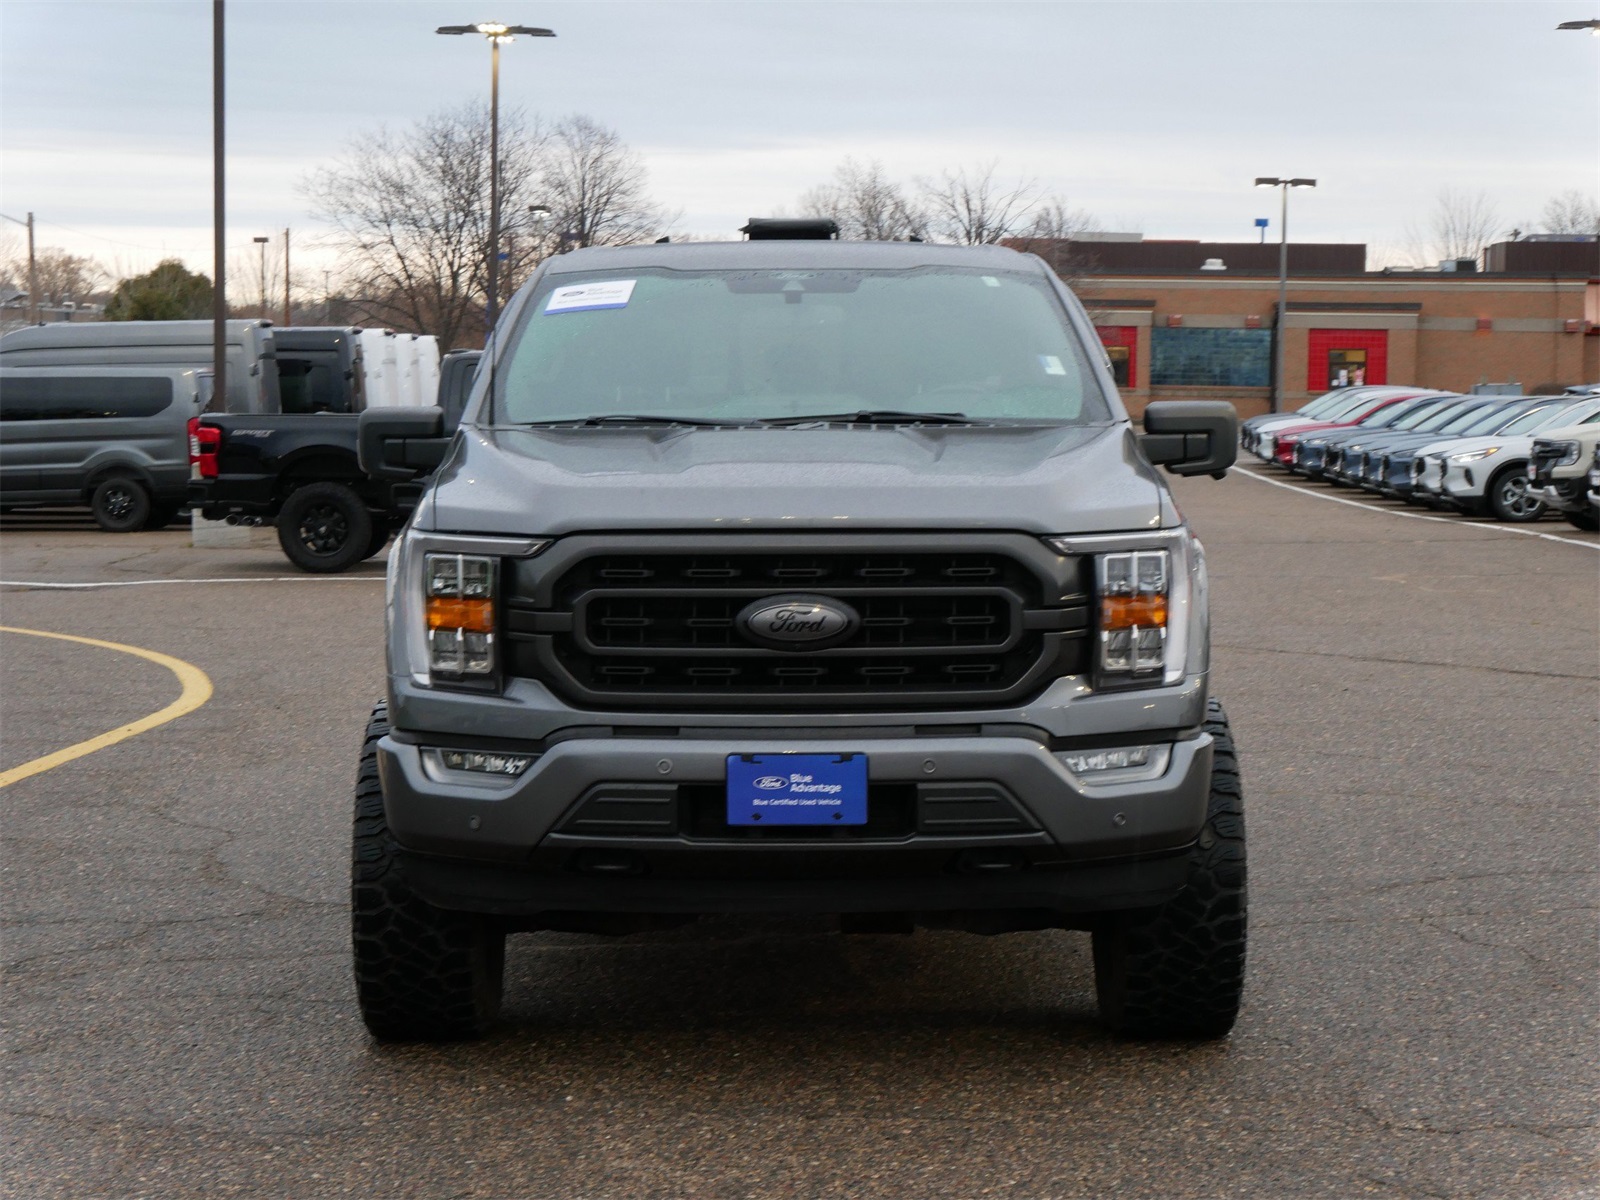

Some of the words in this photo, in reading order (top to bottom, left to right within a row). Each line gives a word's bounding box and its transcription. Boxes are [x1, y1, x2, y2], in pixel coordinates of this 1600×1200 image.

[770, 609, 826, 633] Ford
[790, 774, 812, 783] Blue
[790, 783, 842, 794] Advantage
